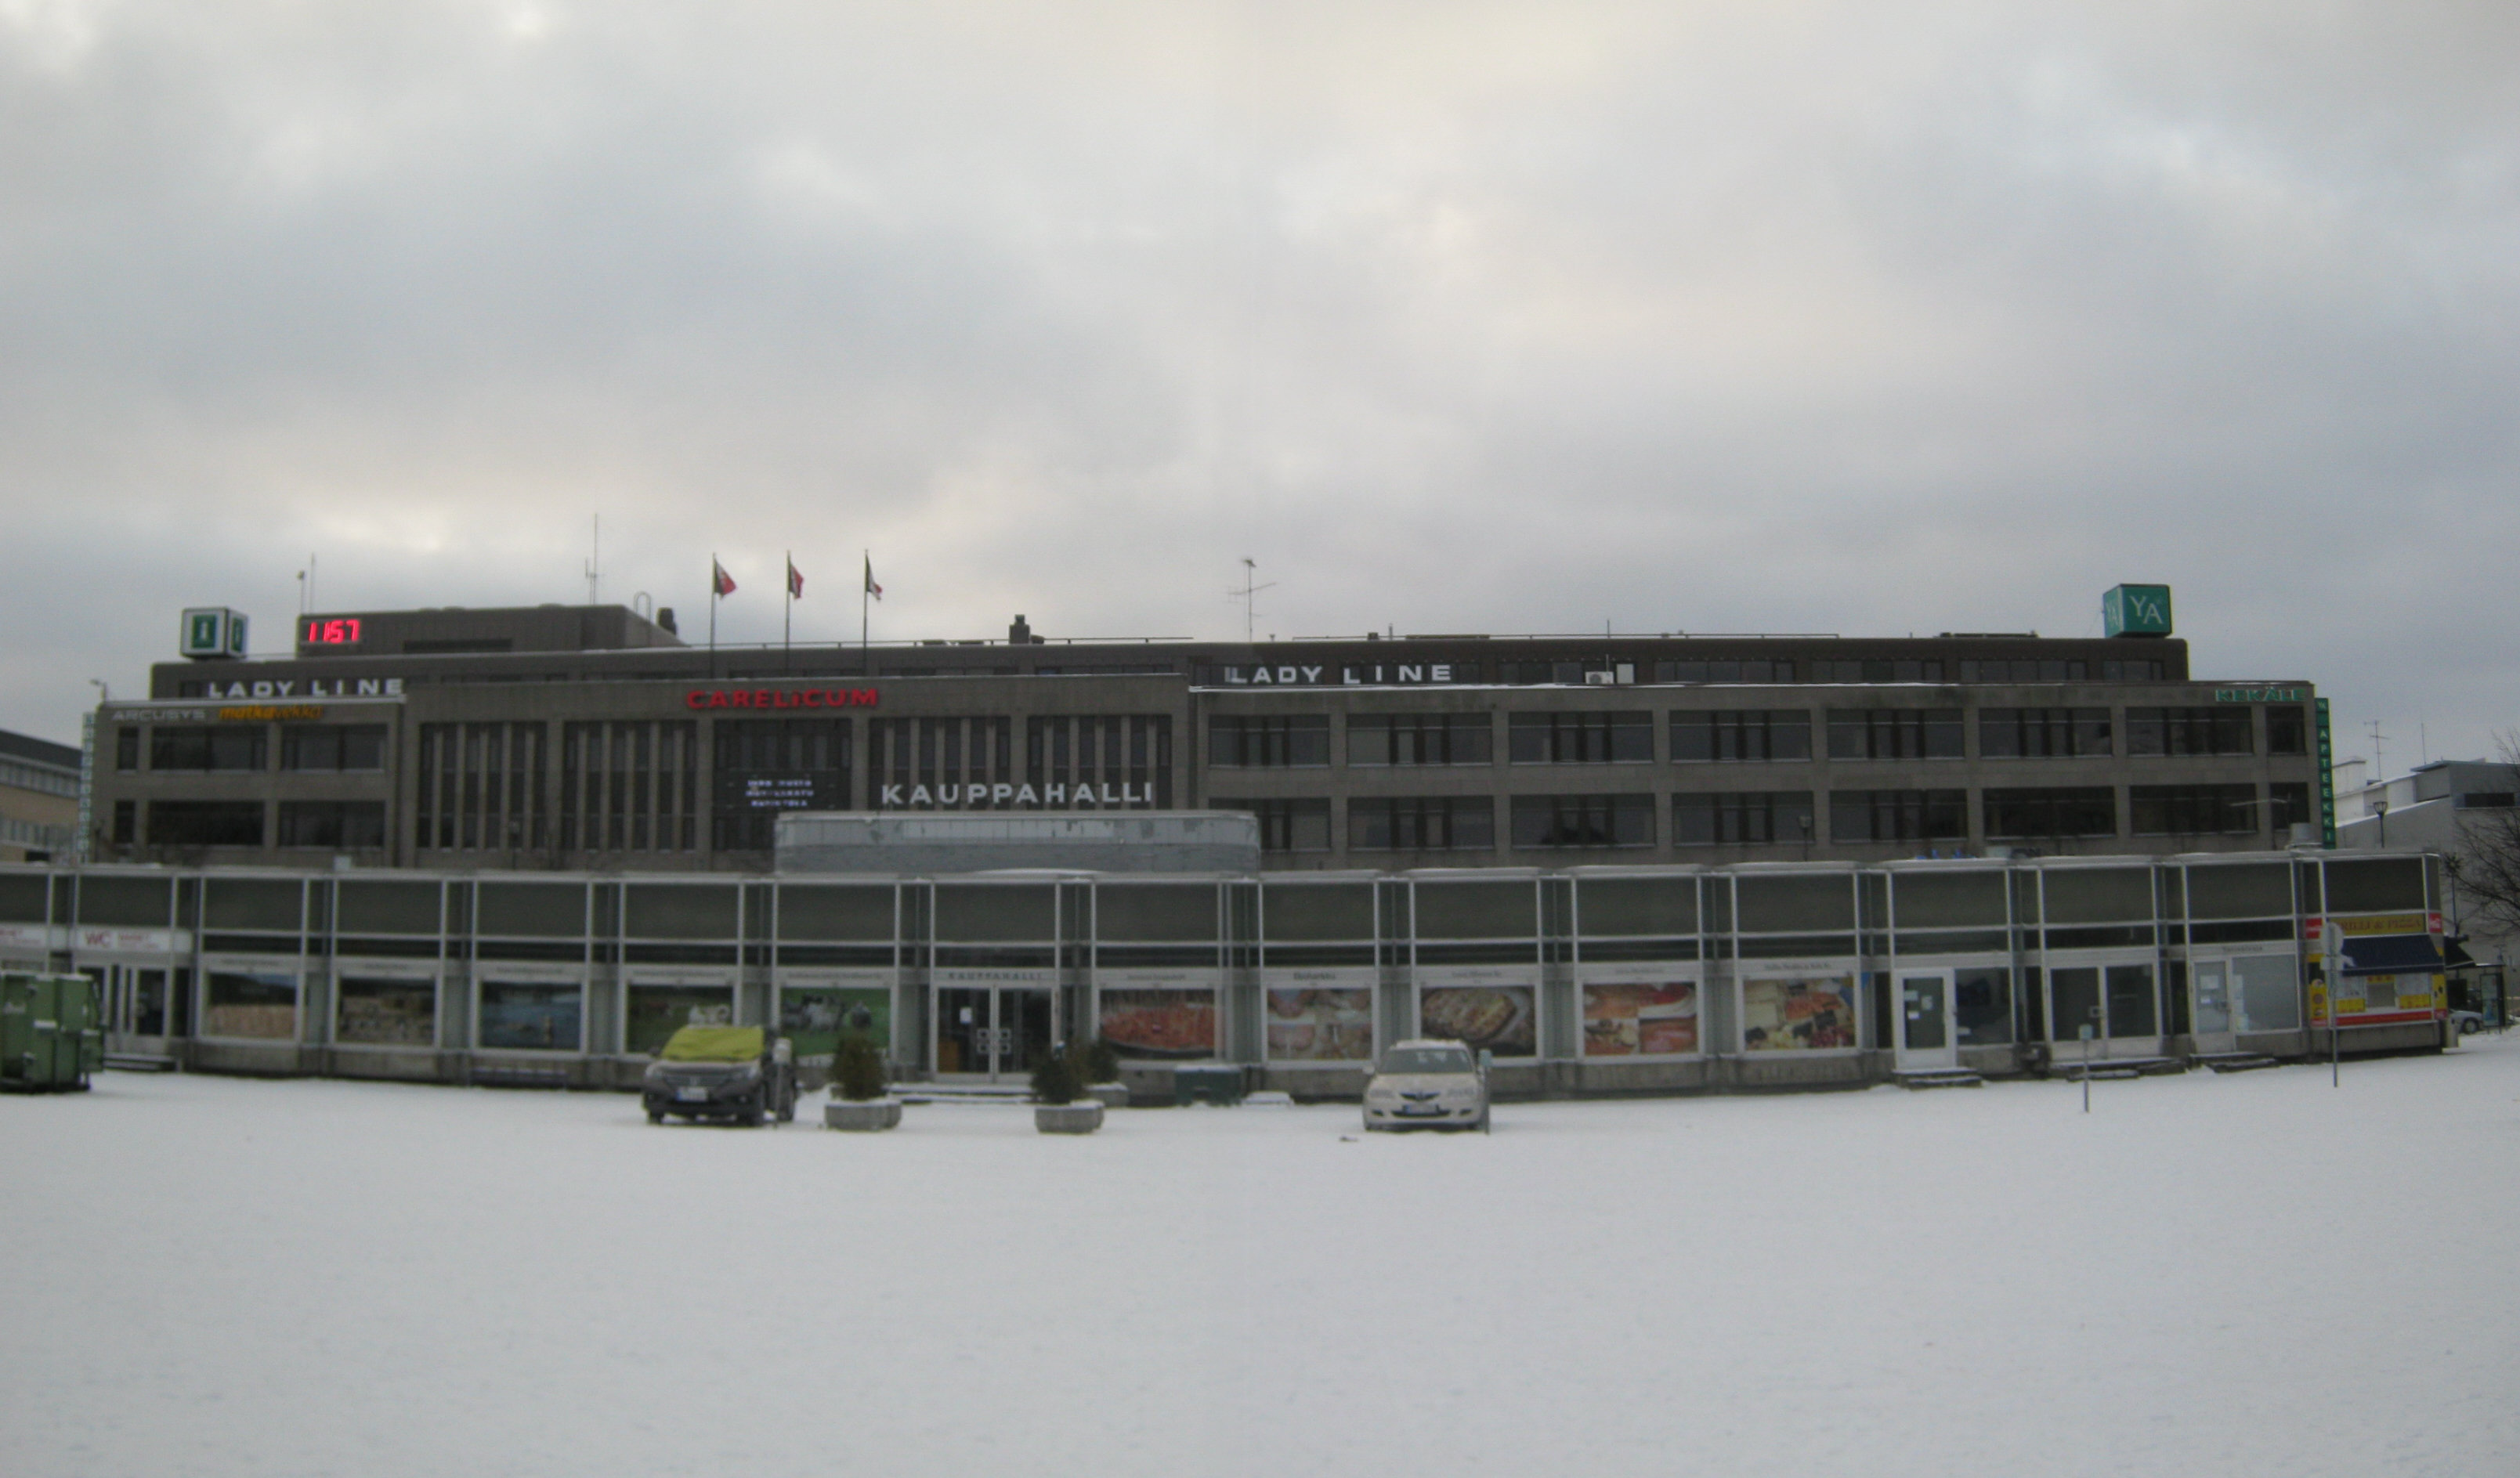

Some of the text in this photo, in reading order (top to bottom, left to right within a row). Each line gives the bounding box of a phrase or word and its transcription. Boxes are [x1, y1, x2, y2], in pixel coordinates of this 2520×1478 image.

[2129, 594, 2164, 624] YA
[1224, 664, 1452, 685] LADY LINE
[208, 678, 404, 699] LADY LINE
[2215, 685, 2307, 702] KEKÄLE
[111, 709, 207, 721] ARCUSYS
[881, 782, 1152, 804] KAUPPAHALLI
[2319, 728, 2332, 840] APTEEKKI
[85, 928, 111, 949] WC
